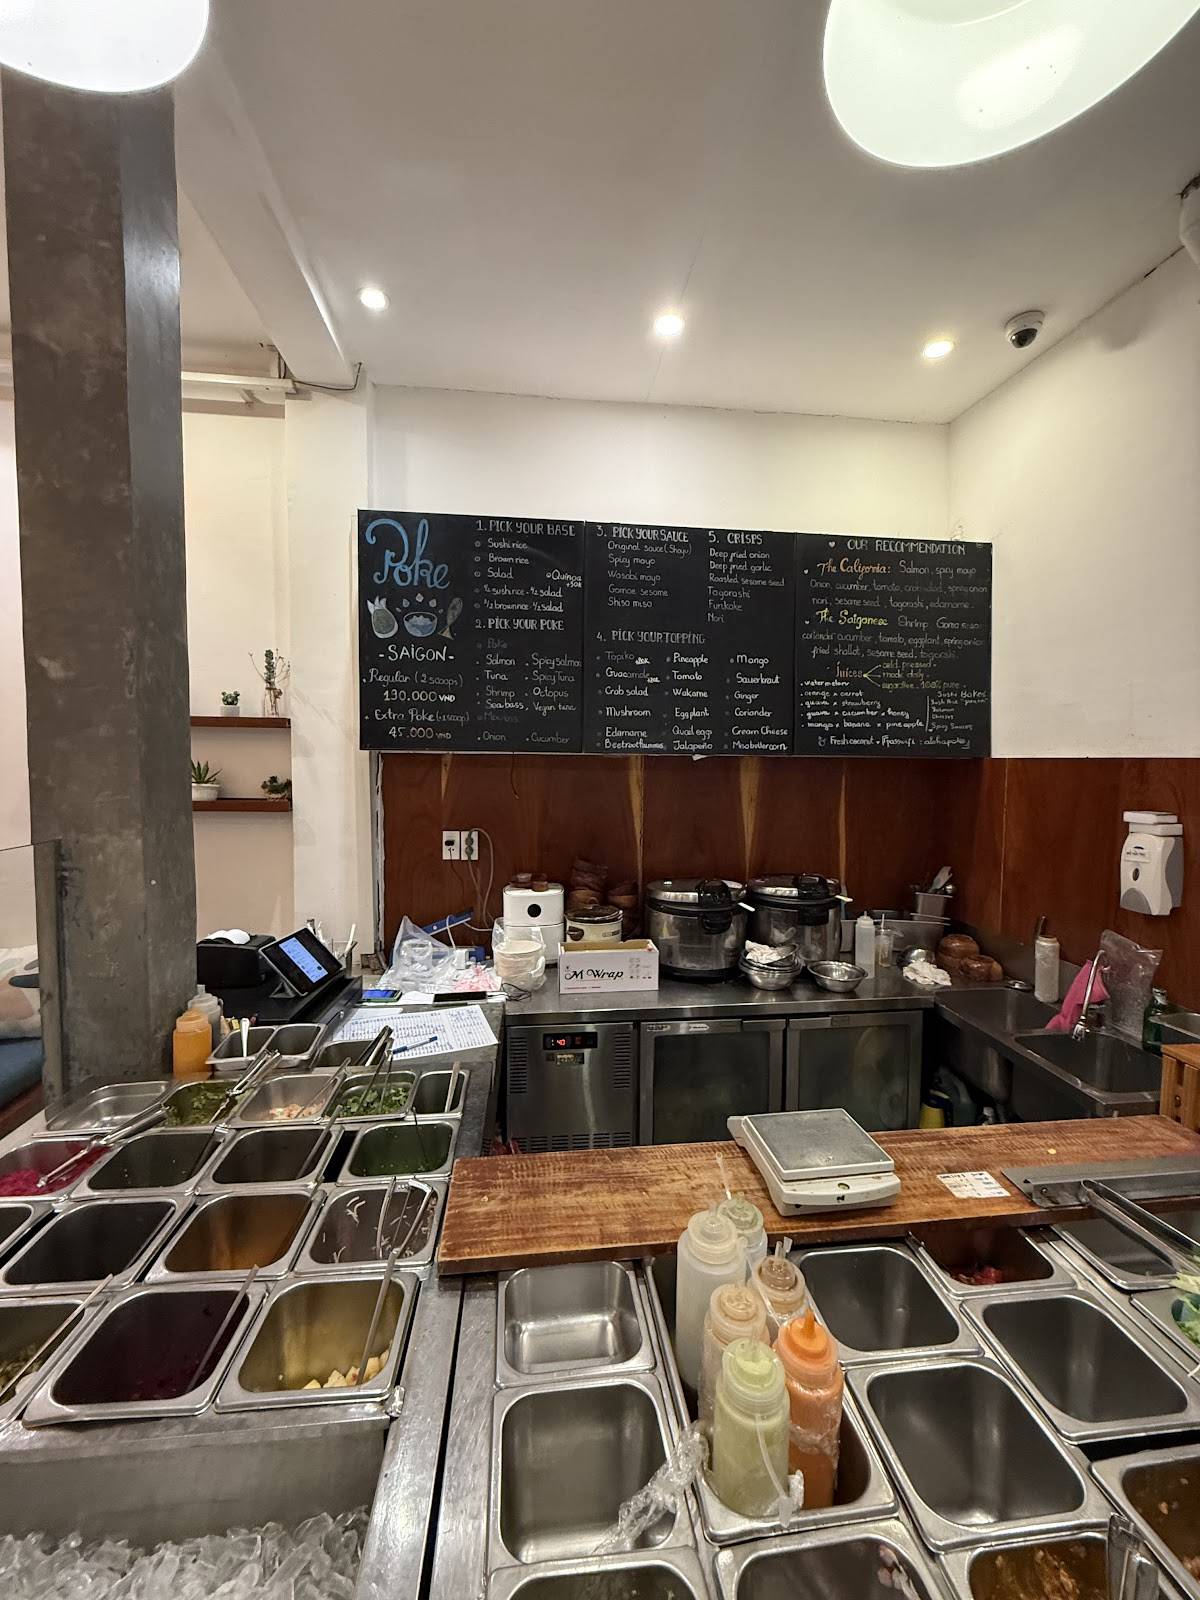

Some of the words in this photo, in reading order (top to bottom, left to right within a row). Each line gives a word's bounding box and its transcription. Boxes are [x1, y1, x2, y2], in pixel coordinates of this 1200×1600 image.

[489, 519, 514, 532] PICK
[515, 522, 544, 535] YOUR
[547, 523, 576, 537] BASE
[612, 526, 635, 539] PICK
[635, 528, 660, 540] YOUR
[660, 529, 689, 543] SAUCE
[708, 531, 720, 543] 5.
[365, 518, 450, 589] Poke
[608, 541, 640, 553] Original
[847, 540, 868, 551] OUR
[875, 540, 967, 556] RECOMMENDATION
[488, 552, 515, 562] Brown
[608, 553, 630, 568] Spicy
[633, 557, 657, 568] mayo
[709, 548, 729, 562] Deep
[729, 550, 748, 562] fried
[749, 551, 770, 559] onion
[487, 567, 514, 579] Salad
[709, 561, 728, 574] Deep
[729, 561, 748, 574] fried
[750, 561, 773, 574] garlic
[816, 558, 837, 576] The
[607, 570, 639, 581] Wasabi
[639, 575, 662, 587] mayo
[709, 573, 740, 584] Roasted
[741, 578, 768, 586] sesame
[768, 578, 786, 587] seed
[608, 596, 631, 607] Shiso
[707, 613, 726, 624] Nori
[815, 607, 836, 623] The
[513, 619, 539, 630] YOUR
[540, 619, 565, 631] POKE
[485, 653, 517, 666] Salmon
[673, 652, 709, 669] Pineapple
[736, 654, 770, 669] Mango
[368, 668, 411, 688] Regular
[484, 669, 509, 681] Tuna
[672, 670, 703, 681] Tomato
[485, 685, 516, 701] Shrimp
[533, 686, 570, 702] Octopus
[605, 685, 626, 696] Crab
[626, 686, 649, 697] salad
[672, 688, 709, 700] Wakame
[734, 690, 761, 705] Ginger
[374, 707, 405, 721] Extra
[407, 708, 435, 723] Poke
[605, 705, 651, 718] Mushroom
[734, 706, 773, 718] Coriander
[482, 731, 507, 742] Onion
[605, 726, 649, 738] Edamame
[672, 725, 696, 736] Quail
[732, 726, 760, 736] Cream
[760, 726, 789, 736] Cheese
[531, 732, 570, 744] Cucumber
[565, 969, 584, 981] M
[586, 968, 624, 981] Wrap
